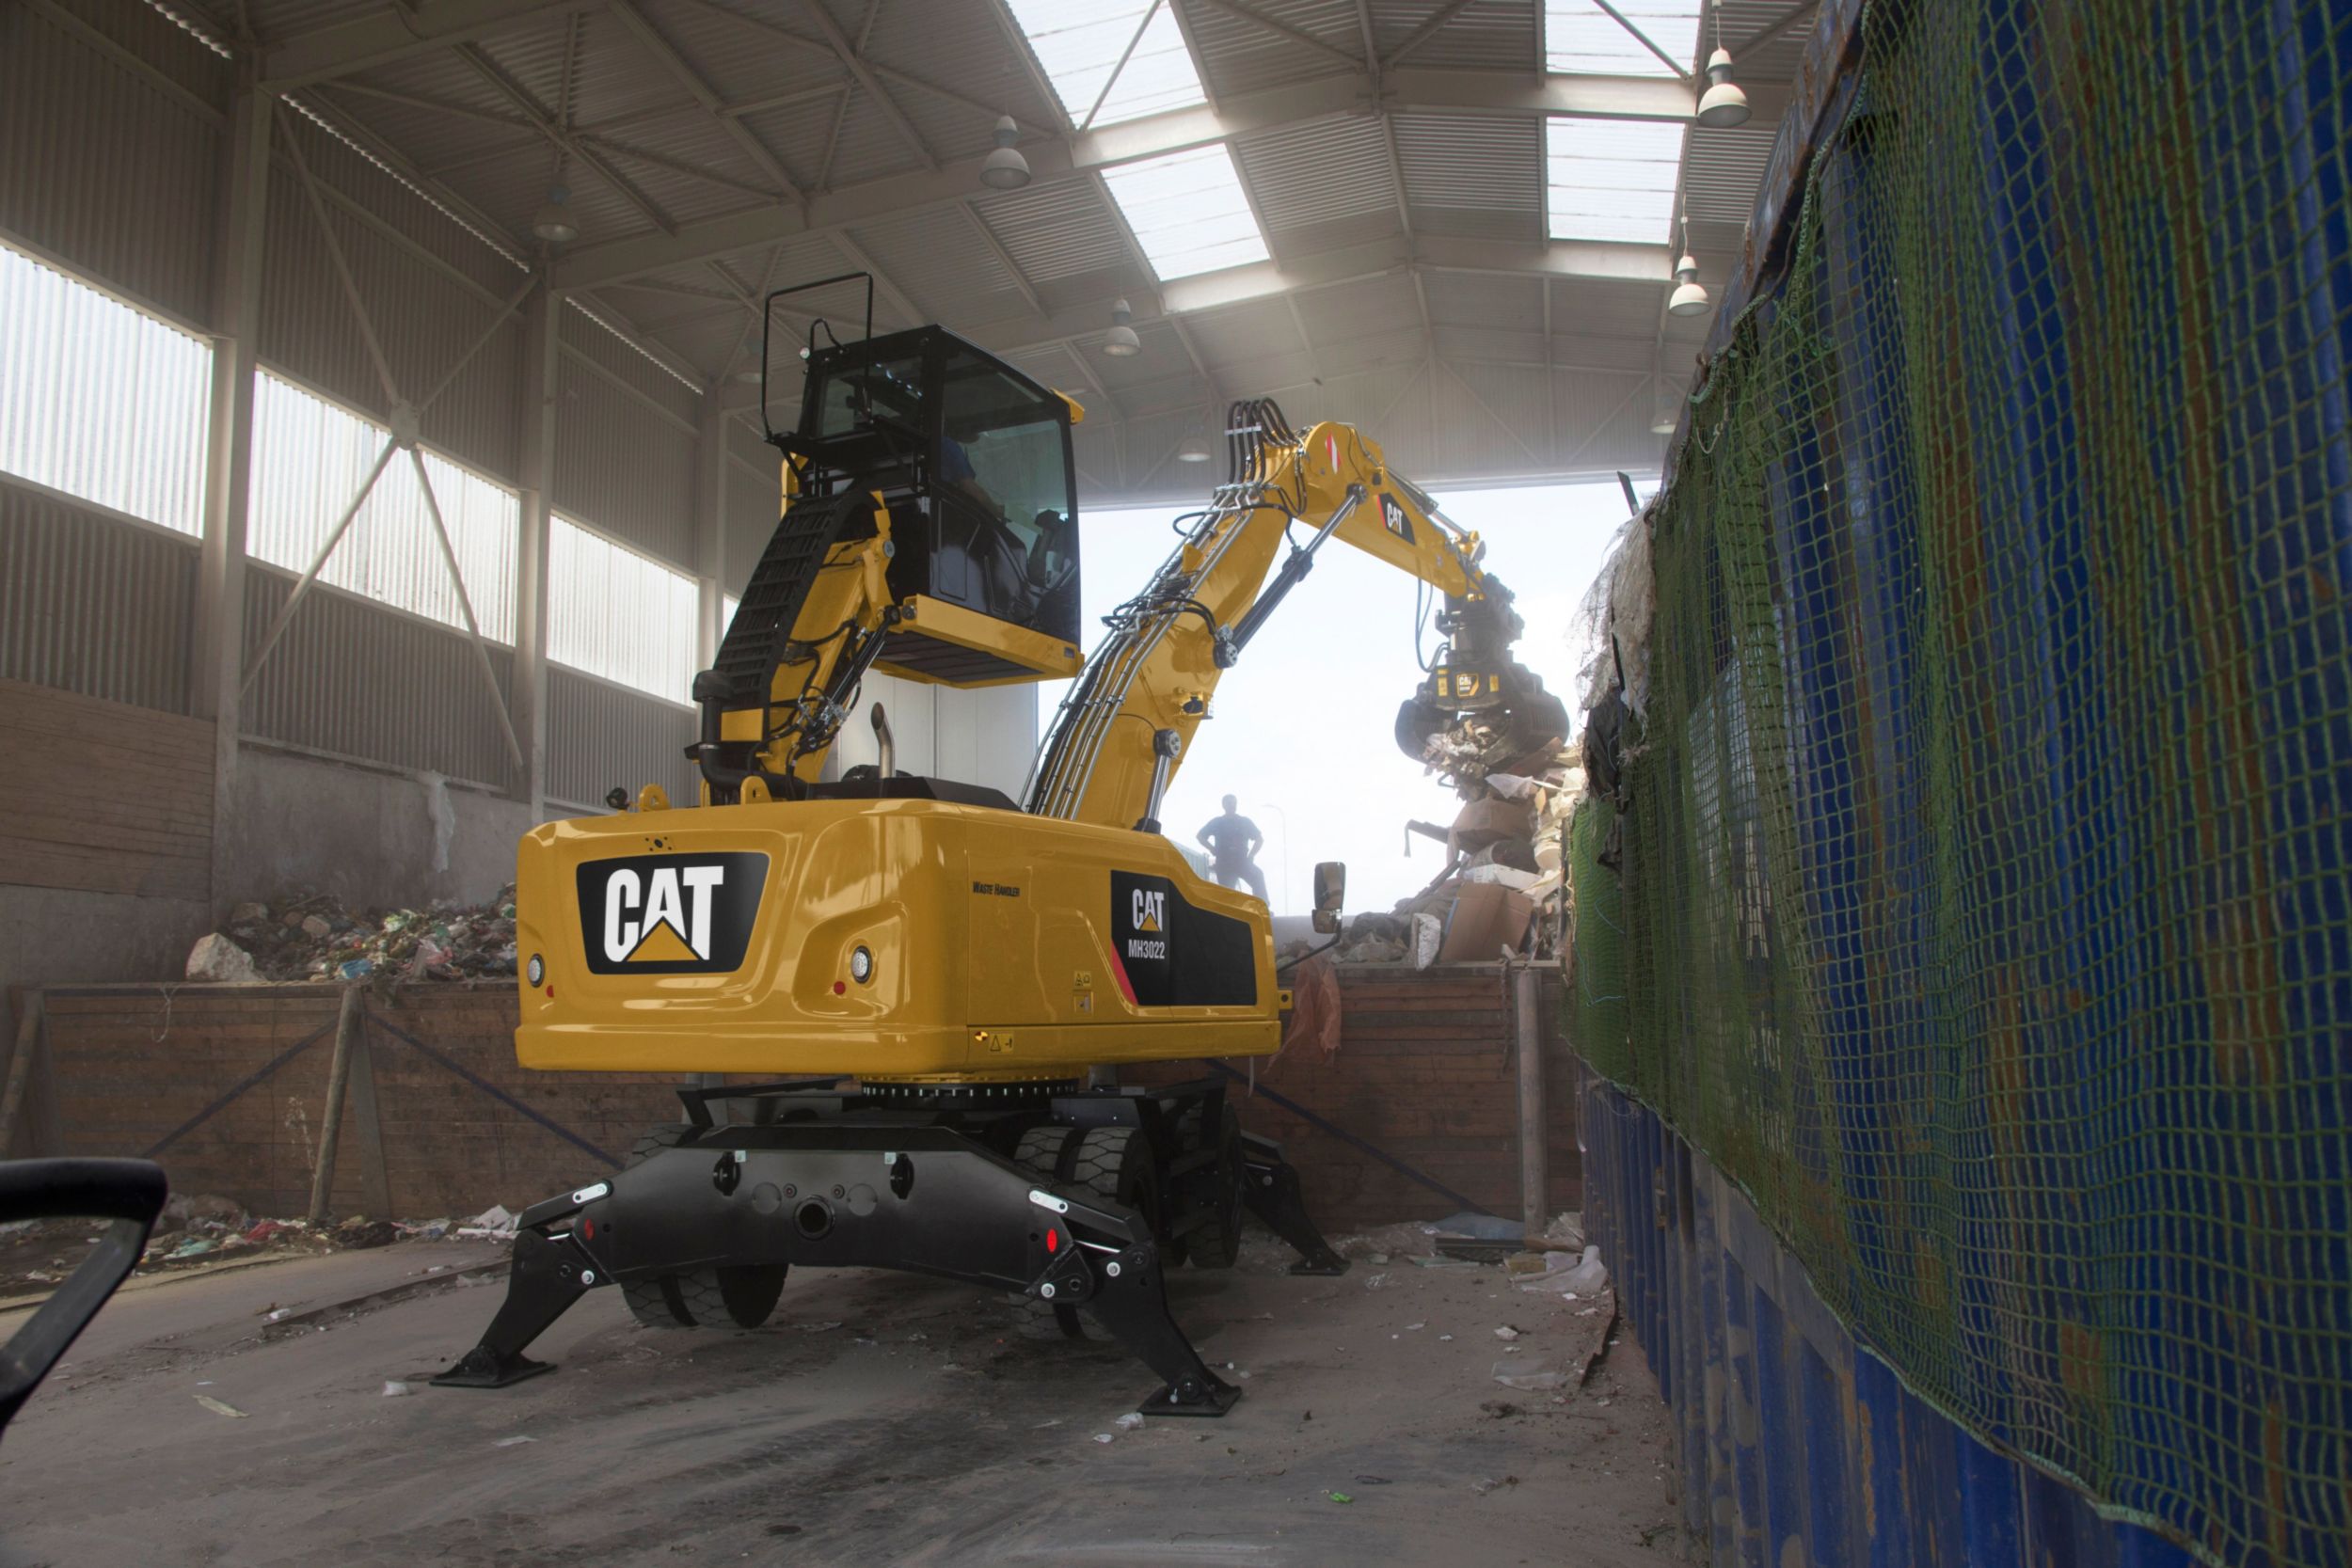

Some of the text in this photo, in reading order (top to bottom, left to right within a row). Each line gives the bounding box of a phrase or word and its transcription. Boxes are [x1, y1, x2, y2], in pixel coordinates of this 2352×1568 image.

[1387, 501, 1403, 535] CAT
[604, 865, 723, 962] CAT
[1132, 888, 1165, 932] CAT
[1128, 939, 1166, 959] MH3022
